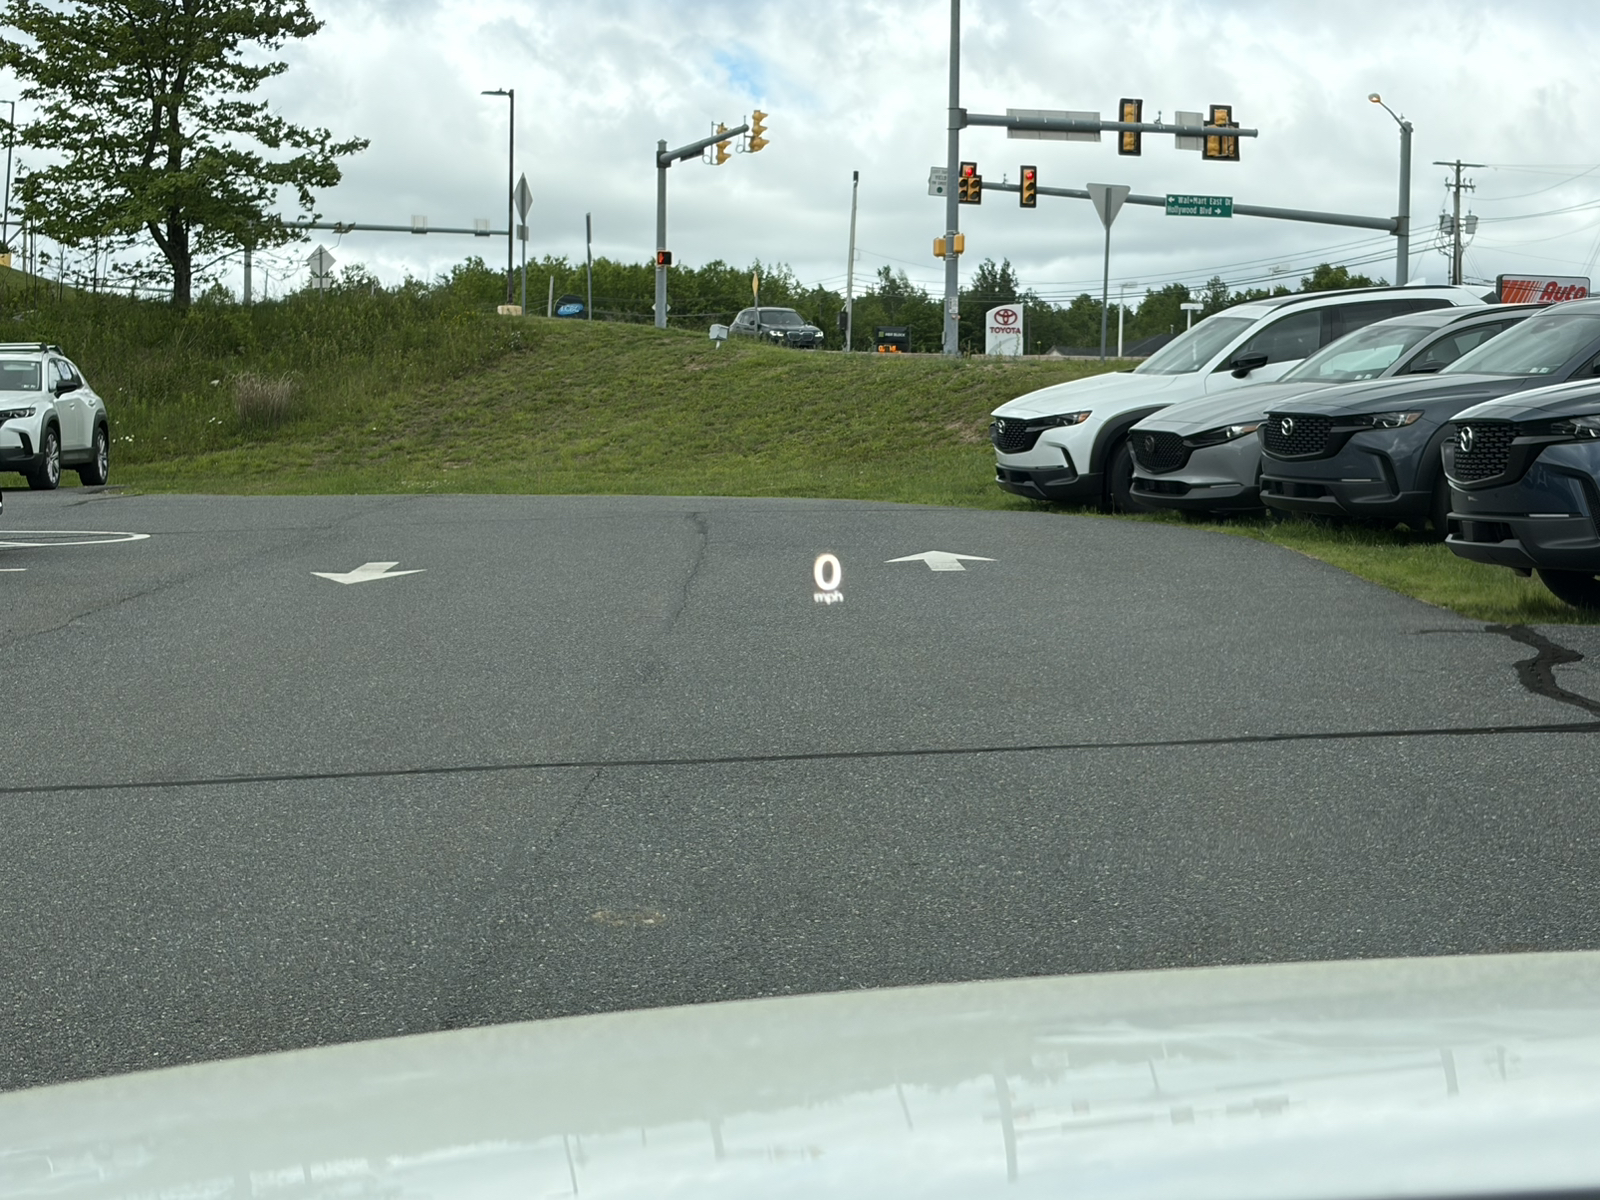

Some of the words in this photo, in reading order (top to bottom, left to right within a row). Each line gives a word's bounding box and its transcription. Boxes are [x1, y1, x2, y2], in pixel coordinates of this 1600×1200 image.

[1209, 198, 1223, 206] East
[1224, 198, 1232, 206] Dr
[1167, 205, 1198, 215] Hollywood
[1199, 207, 1212, 215] Blvd
[1539, 281, 1587, 302] Auto
[989, 326, 1021, 334] TOYOTA
[813, 553, 842, 590] 0
